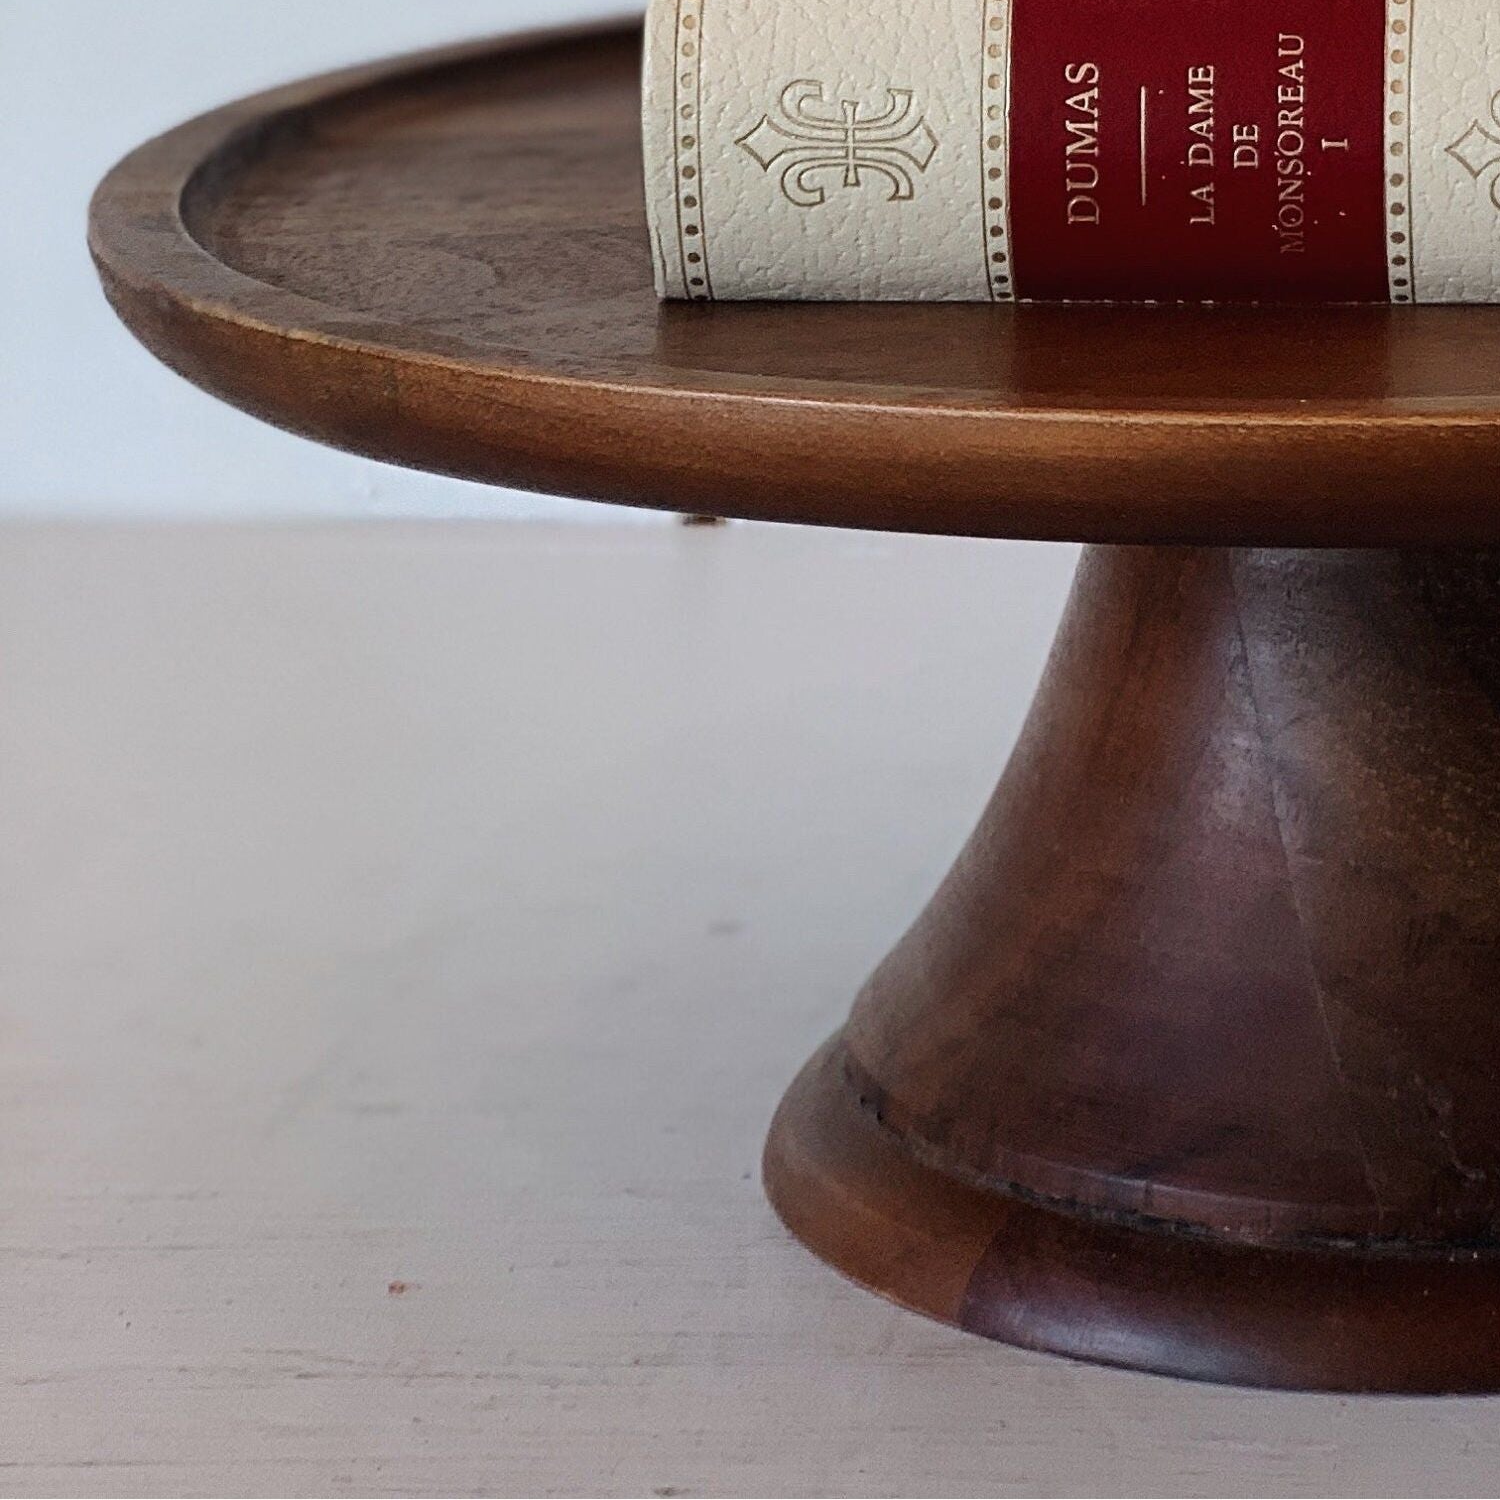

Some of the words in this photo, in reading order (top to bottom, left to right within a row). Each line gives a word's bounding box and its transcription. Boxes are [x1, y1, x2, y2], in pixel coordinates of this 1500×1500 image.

[1065, 62, 1100, 225] DUMAS
[1188, 64, 1214, 167] DAME
[1233, 124, 1259, 169] DE
[1277, 32, 1304, 253] MONSOREAU
[1321, 137, 1348, 151] I
[1190, 182, 1215, 225] LA
